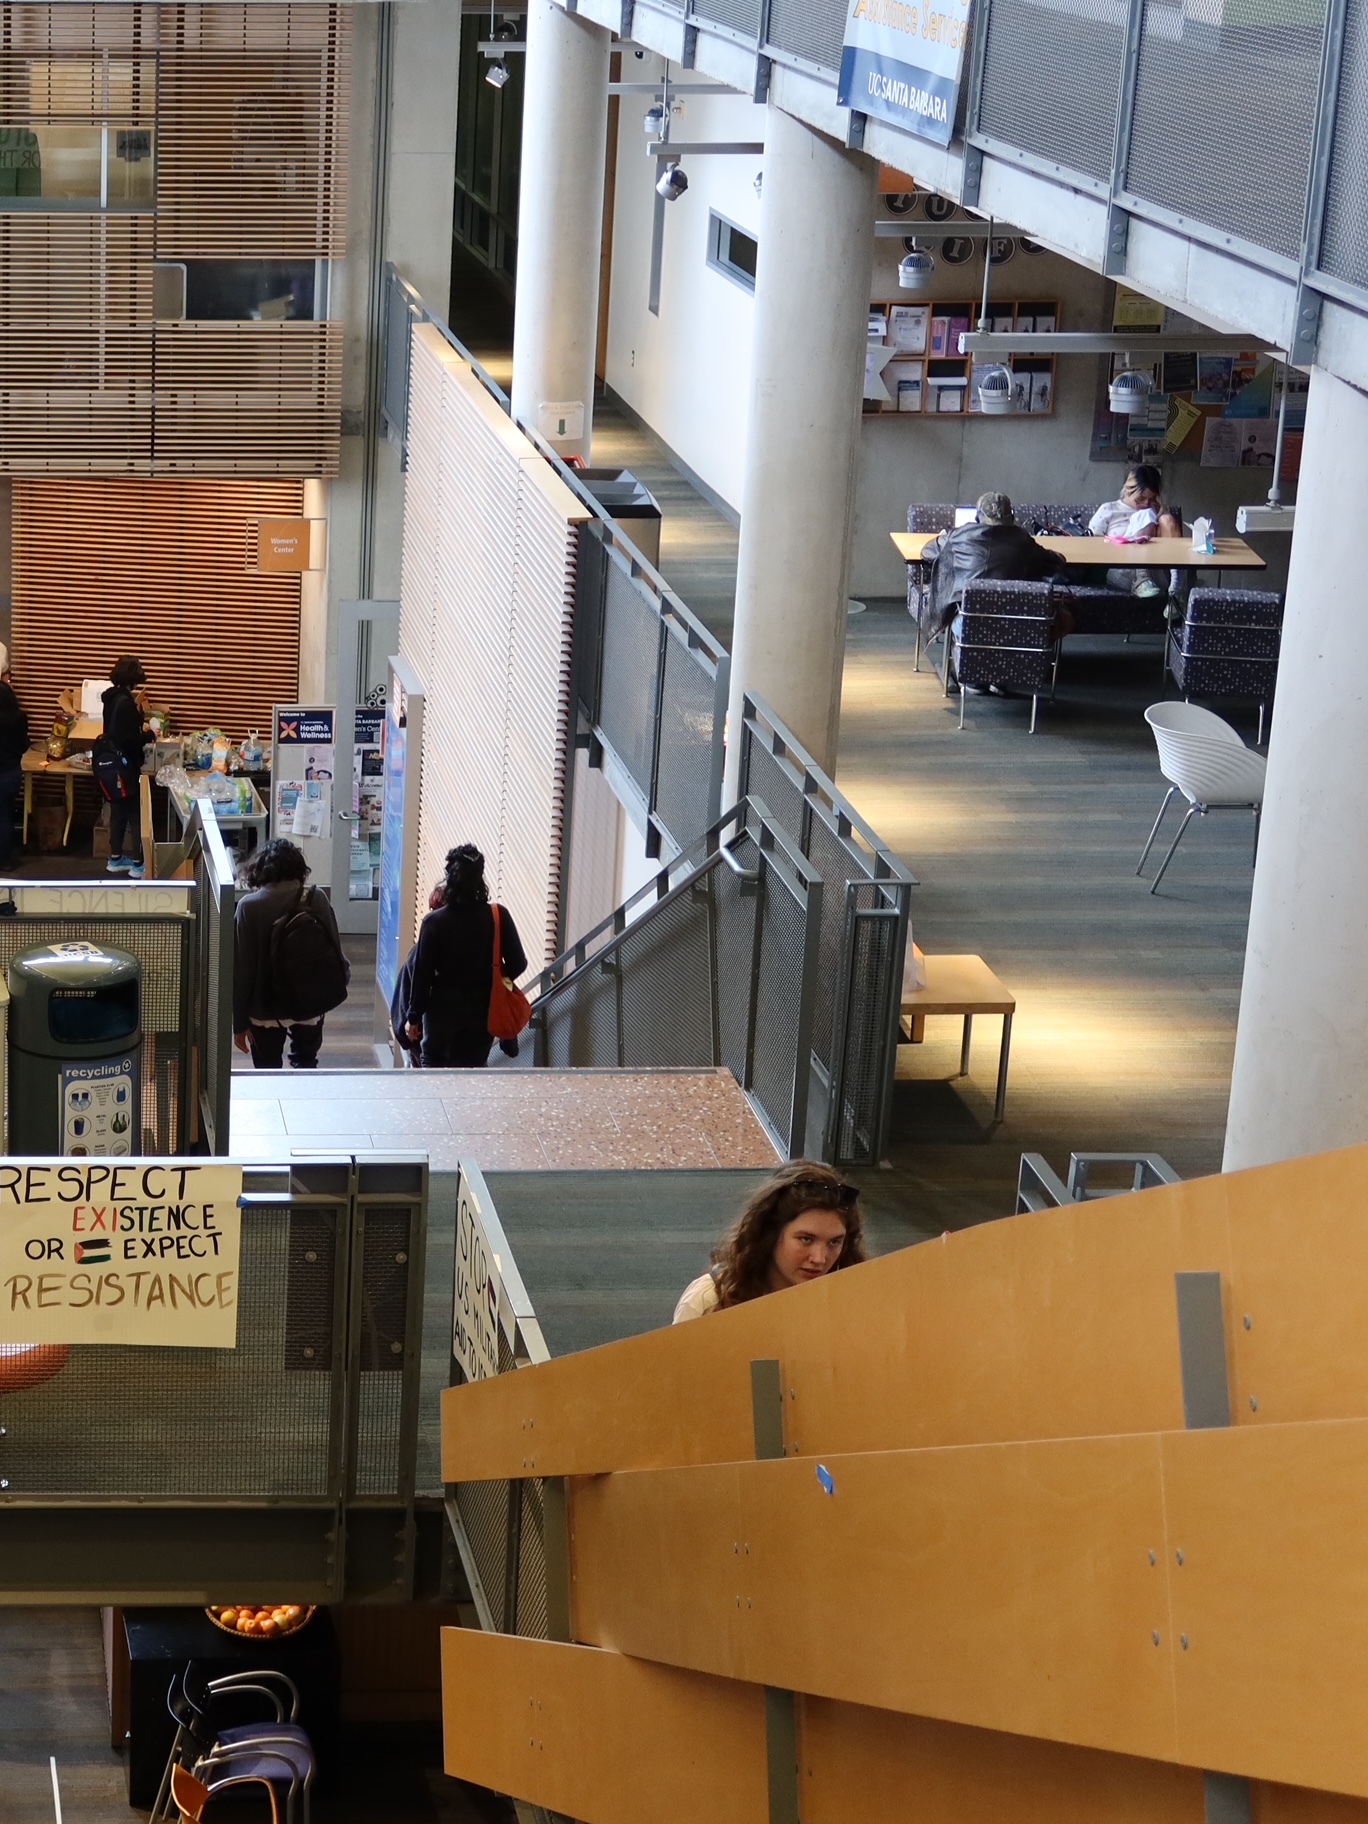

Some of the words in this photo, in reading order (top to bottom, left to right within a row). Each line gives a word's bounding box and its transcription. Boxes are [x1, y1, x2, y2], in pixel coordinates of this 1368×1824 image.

[868, 72, 882, 96] UC
[881, 78, 909, 108] SANTA
[300, 731, 332, 739] Wellness
[65, 1065, 121, 1079] recycling
[72, 1203, 217, 1233] EXISTENCE
[24, 1238, 65, 1261] OR
[122, 1231, 222, 1261] EXPECT
[459, 1200, 488, 1313] STOP
[3, 1269, 235, 1313] RESISTANCE
[456, 1266, 470, 1318] U.S.
[454, 1316, 467, 1355] AID
[467, 1335, 477, 1378] TO
